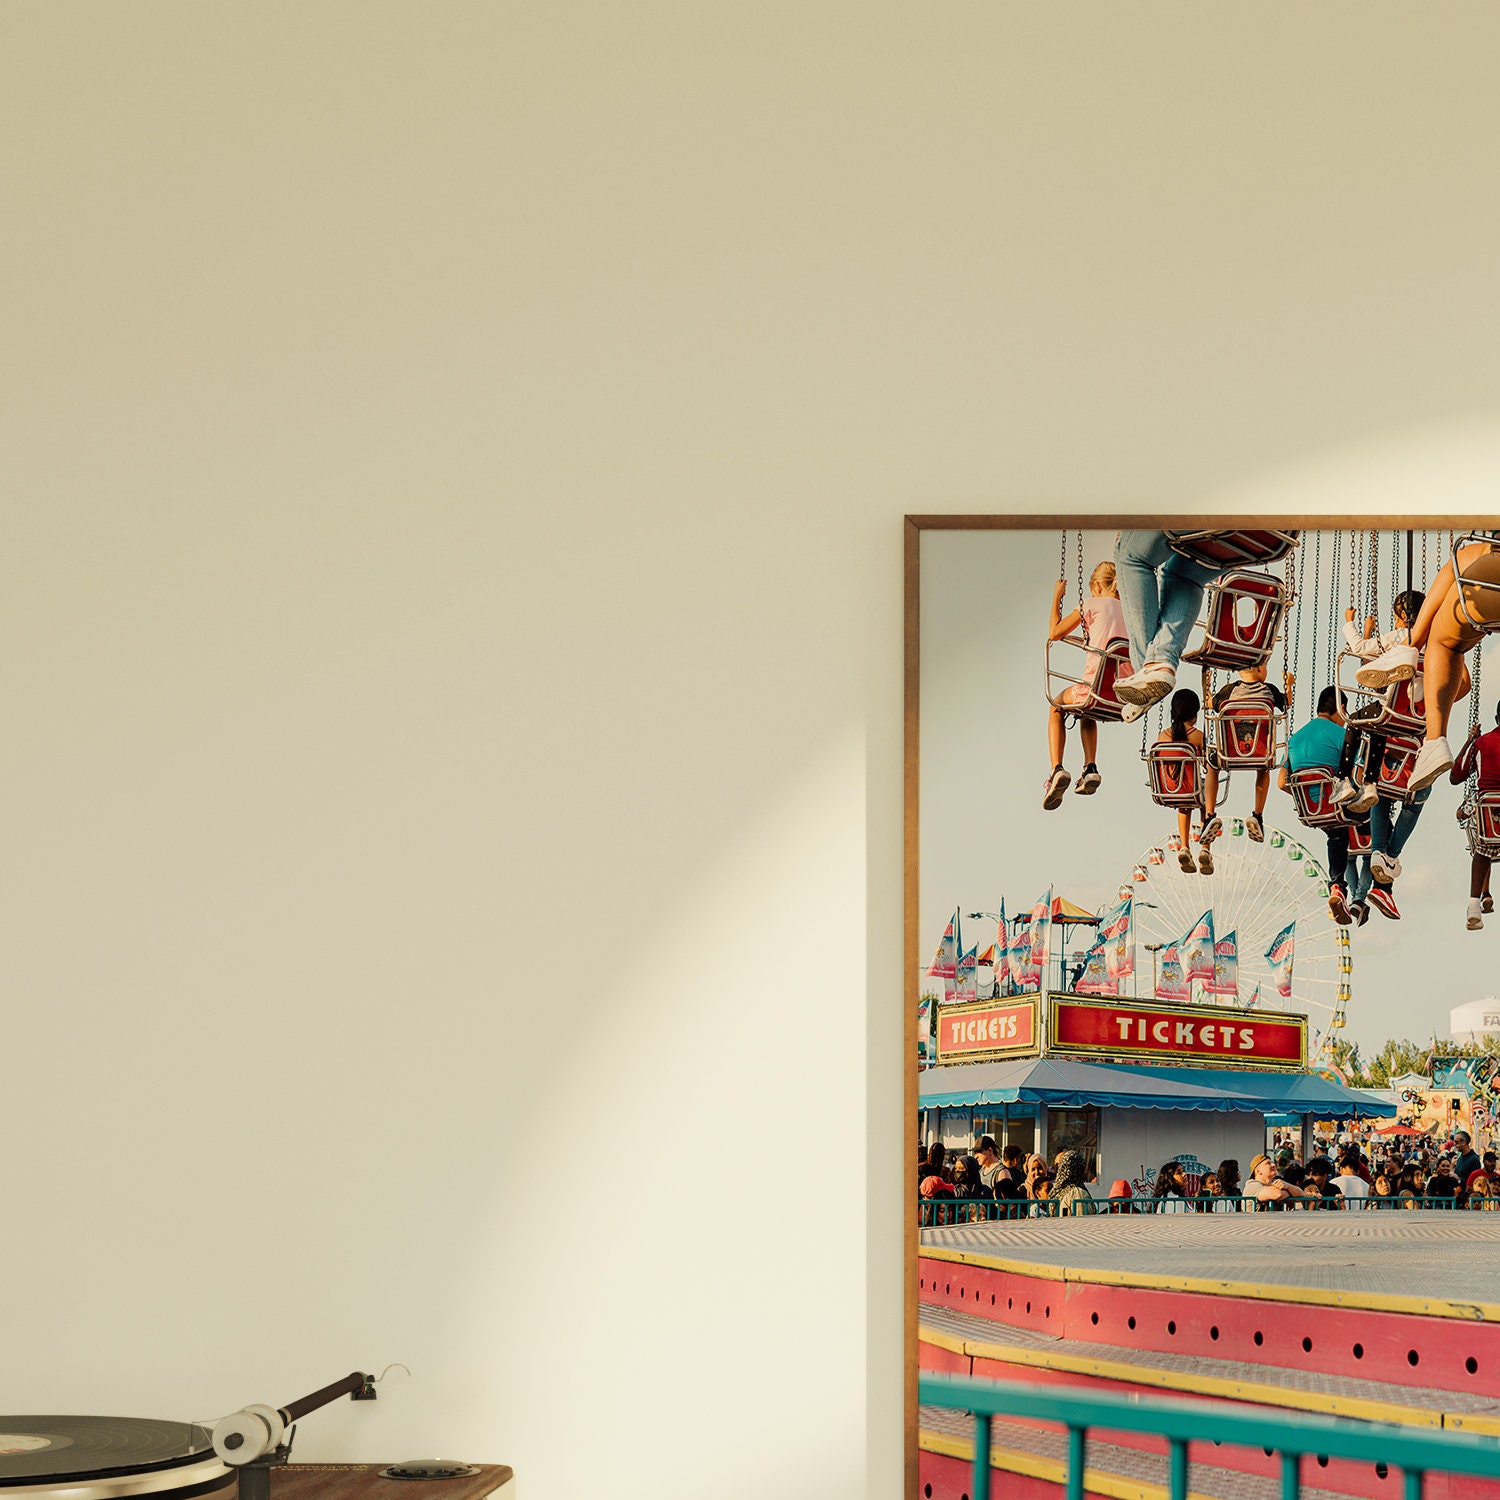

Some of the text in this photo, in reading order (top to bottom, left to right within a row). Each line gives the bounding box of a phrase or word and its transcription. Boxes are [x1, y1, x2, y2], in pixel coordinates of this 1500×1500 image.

[1388, 770, 1394, 778] 7
[952, 1015, 1017, 1044] TICKETS
[1116, 1017, 1254, 1050] TICKETS
